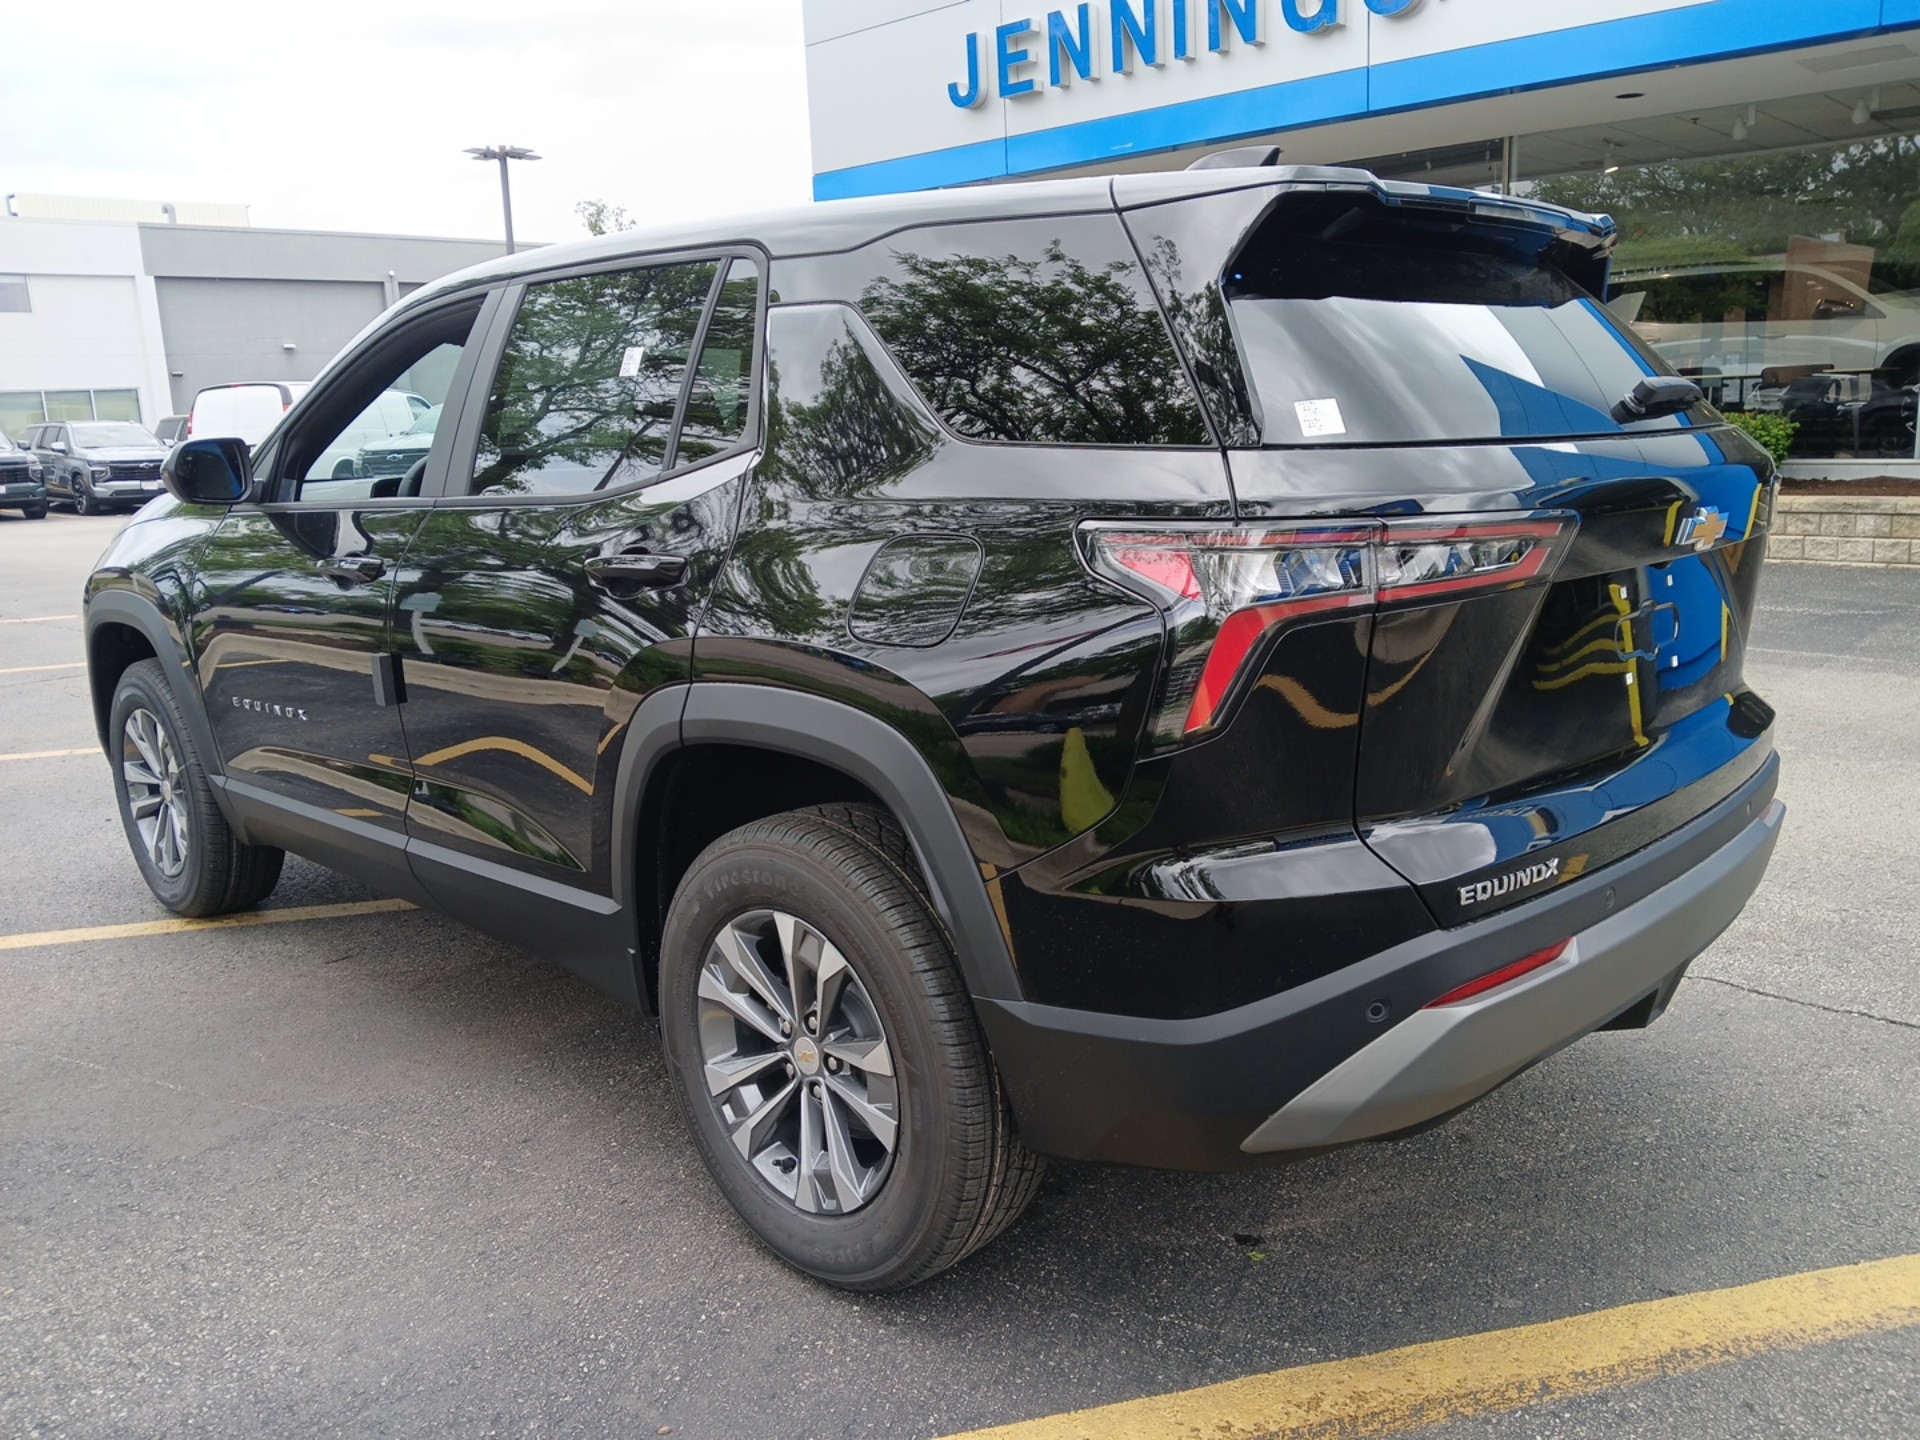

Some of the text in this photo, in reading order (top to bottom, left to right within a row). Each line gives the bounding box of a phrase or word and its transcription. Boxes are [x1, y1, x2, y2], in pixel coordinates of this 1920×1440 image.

[947, 0, 1410, 109] JENNIN
[232, 696, 307, 721] EQUINOX
[1457, 857, 1560, 906] EQUINOX
